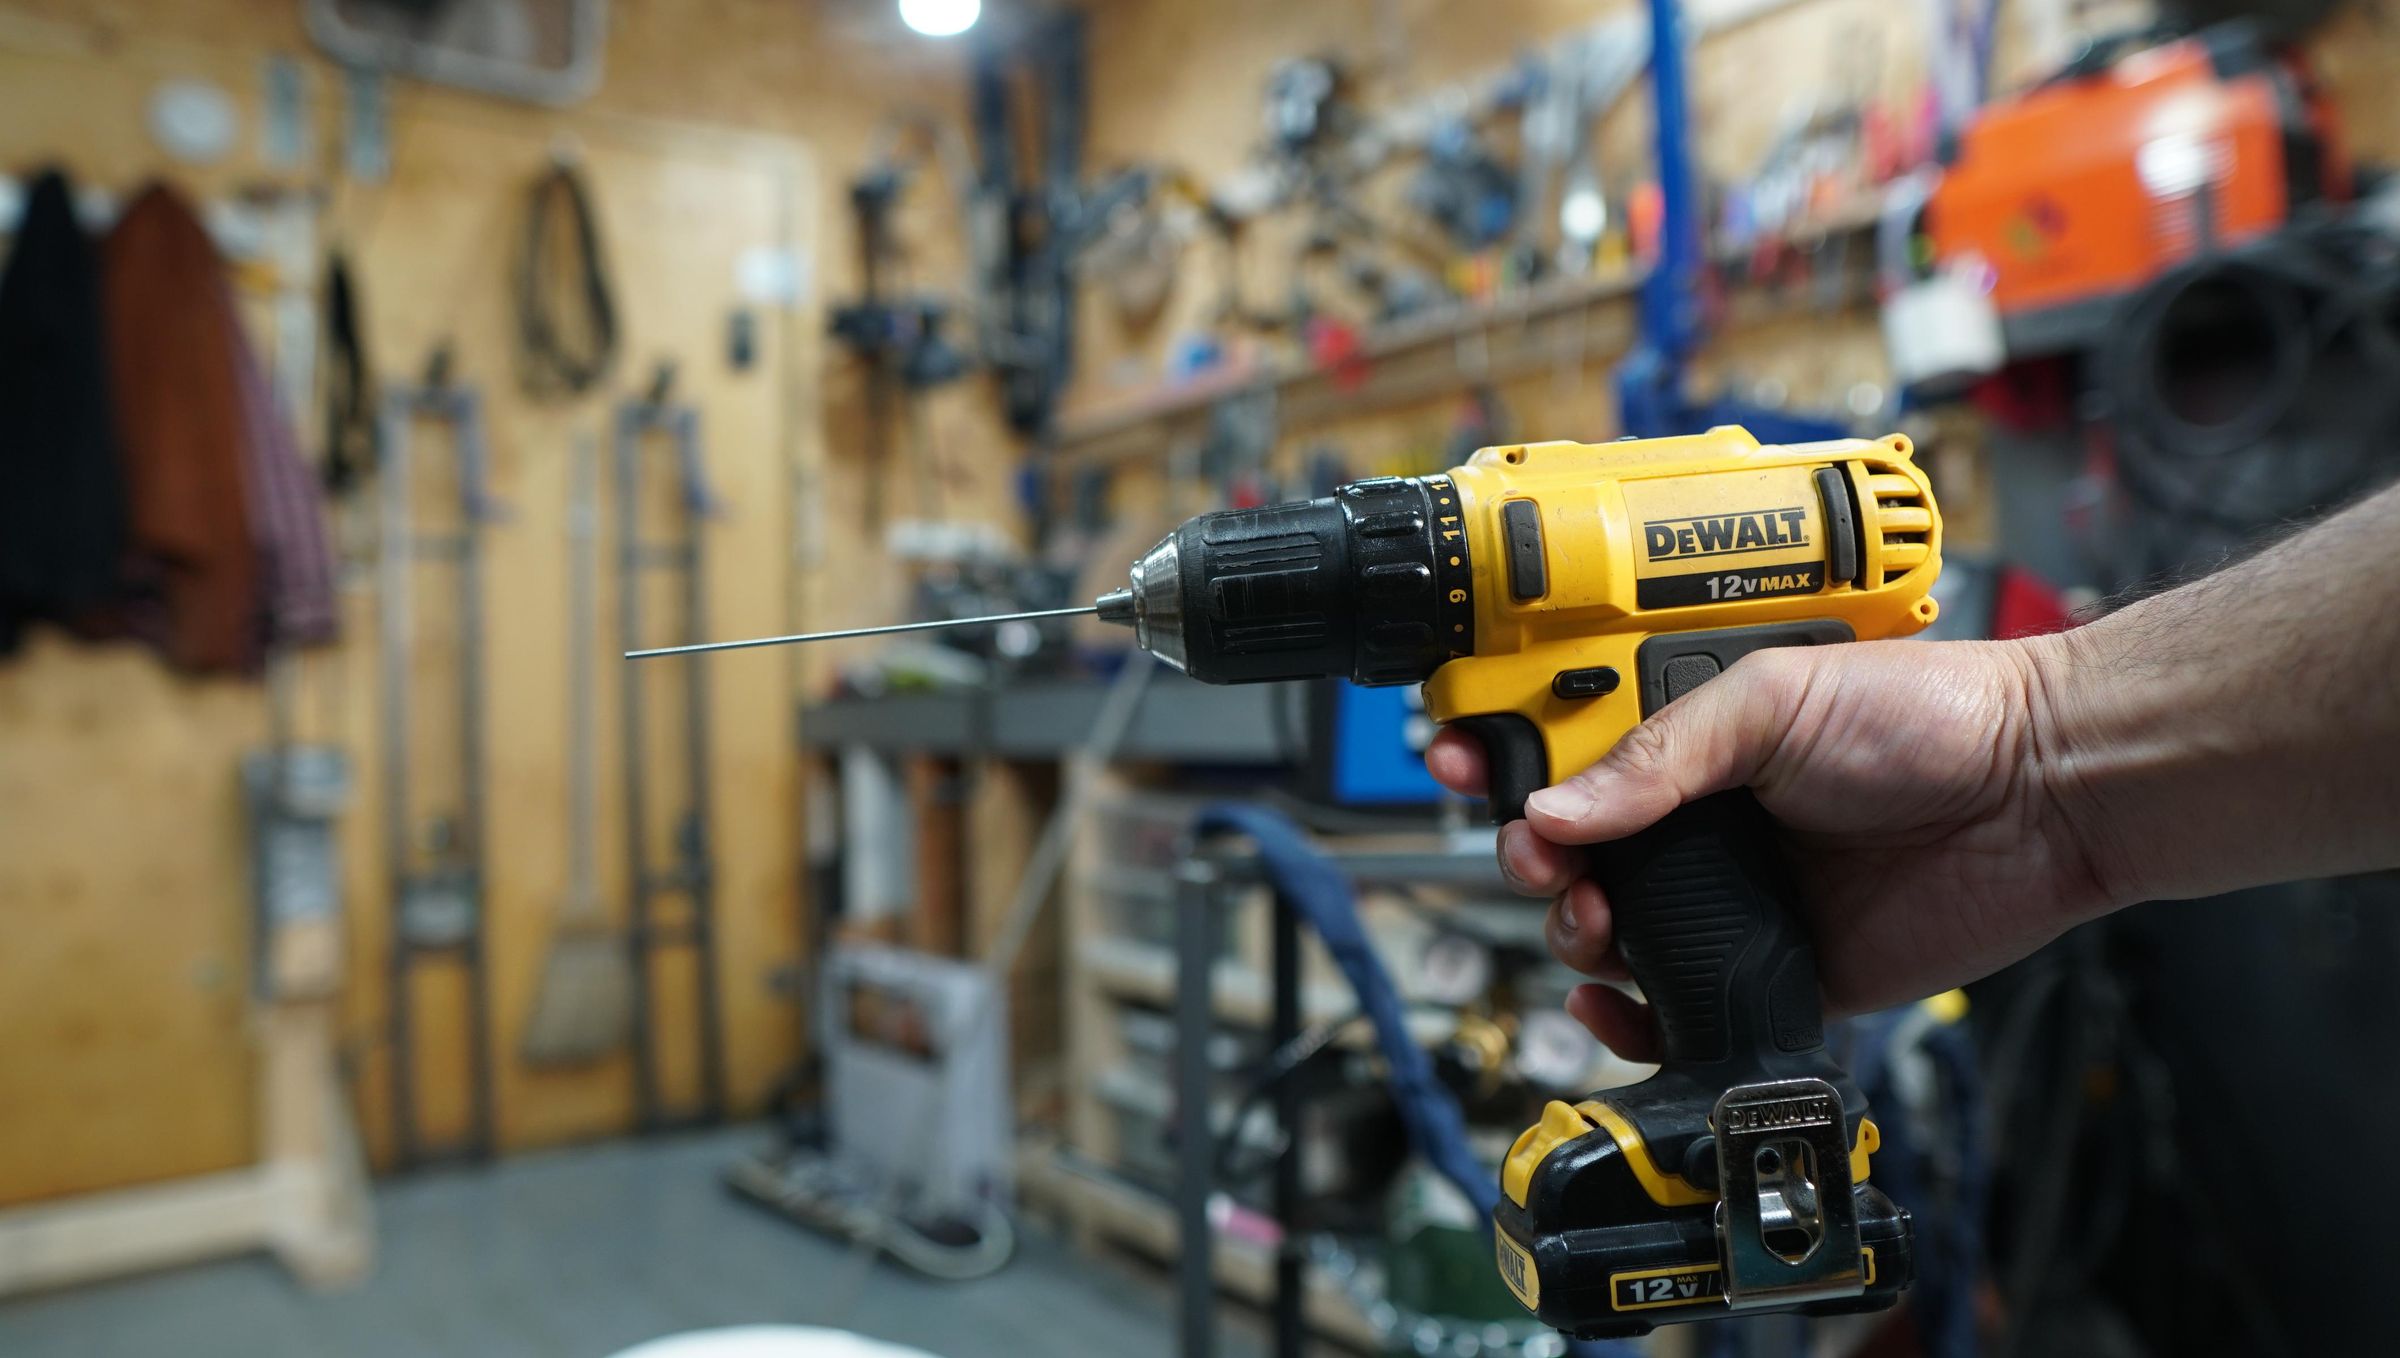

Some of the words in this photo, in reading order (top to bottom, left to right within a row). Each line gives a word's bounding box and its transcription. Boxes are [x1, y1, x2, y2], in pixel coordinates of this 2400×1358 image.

[1431, 480, 1449, 490] 1
[1440, 515, 1460, 541] 11
[1760, 572, 1811, 592] MAX
[1449, 588, 1467, 604] 9
[1676, 1275, 1698, 1284] MAX
